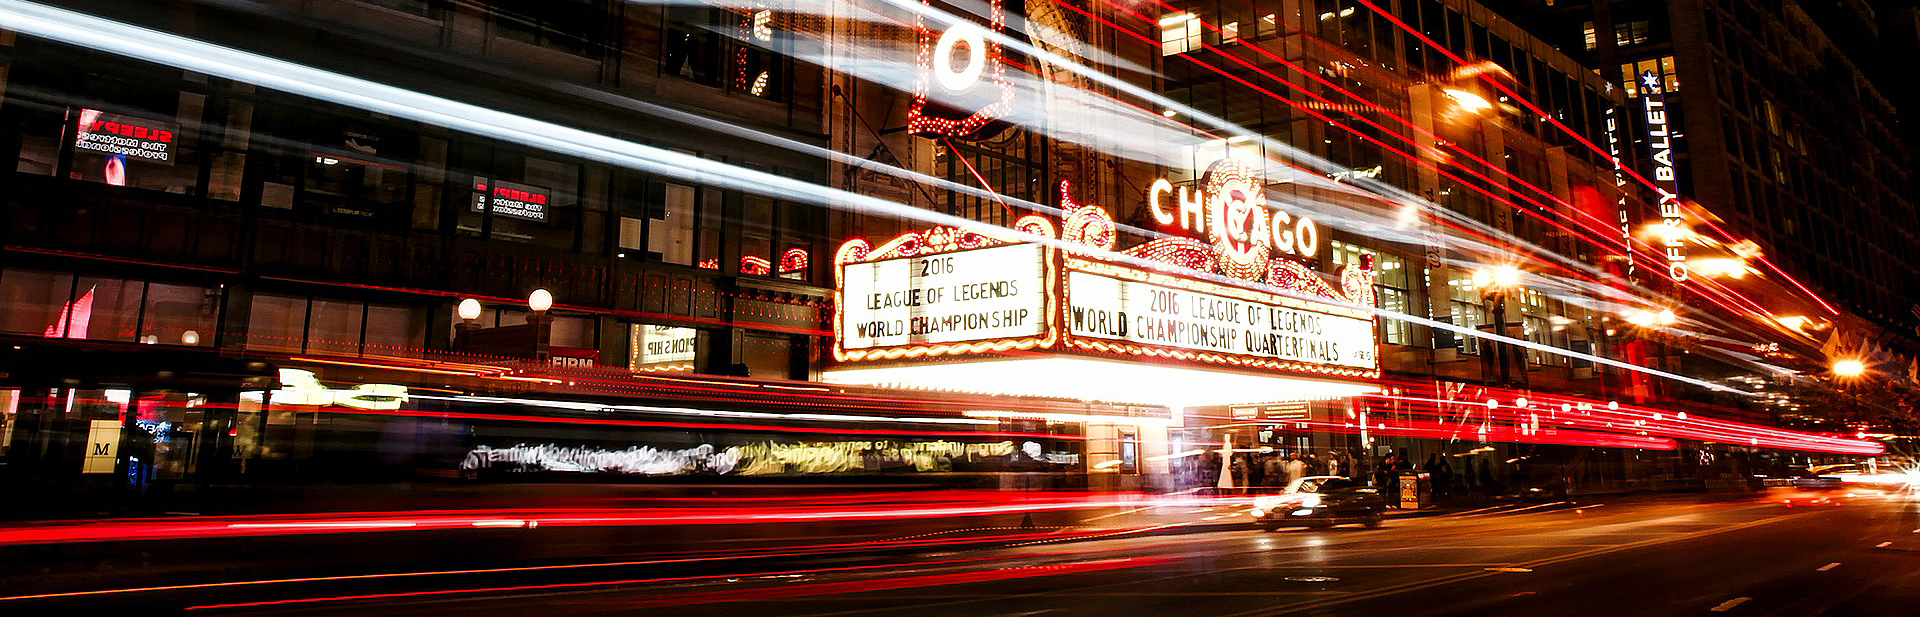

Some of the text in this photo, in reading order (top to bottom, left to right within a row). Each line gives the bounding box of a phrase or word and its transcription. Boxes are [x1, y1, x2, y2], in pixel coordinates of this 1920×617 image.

[1645, 97, 1675, 181] BALLET
[1149, 178, 1318, 257] CHICAGO
[921, 257, 954, 277] 2016
[867, 280, 1018, 310] LEAGUE OF LEGENDS
[857, 309, 1028, 339] WORLD CHAMPIONSHIP
[1150, 289, 1322, 335] 2016 LEAGUE OF LEGENDS
[1072, 306, 1339, 362] WORLD CHAMPIONSHIP QUARTERFINALS
[552, 356, 594, 371] FIRM
[93, 443, 110, 456] M
